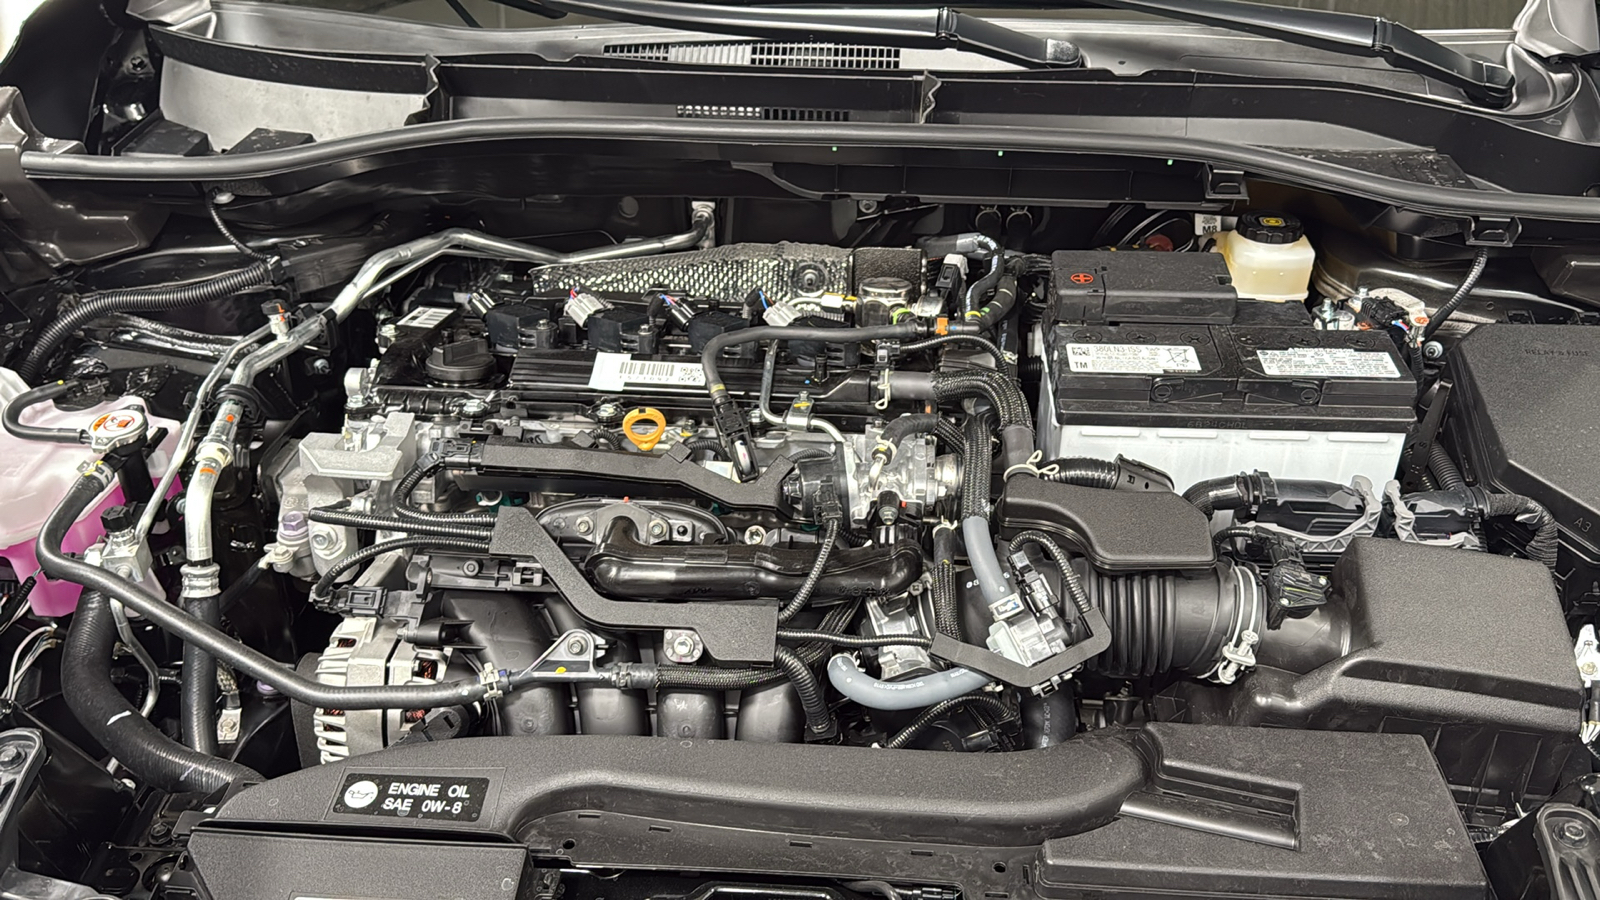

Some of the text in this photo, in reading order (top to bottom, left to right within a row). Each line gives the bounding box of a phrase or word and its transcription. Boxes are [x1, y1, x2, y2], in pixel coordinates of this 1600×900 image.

[1202, 225, 1218, 234] M8
[1073, 361, 1088, 369] TM
[1573, 517, 1592, 533] A3
[387, 782, 470, 798] ENGINE OIL
[382, 798, 463, 814] SAE 0W-8
